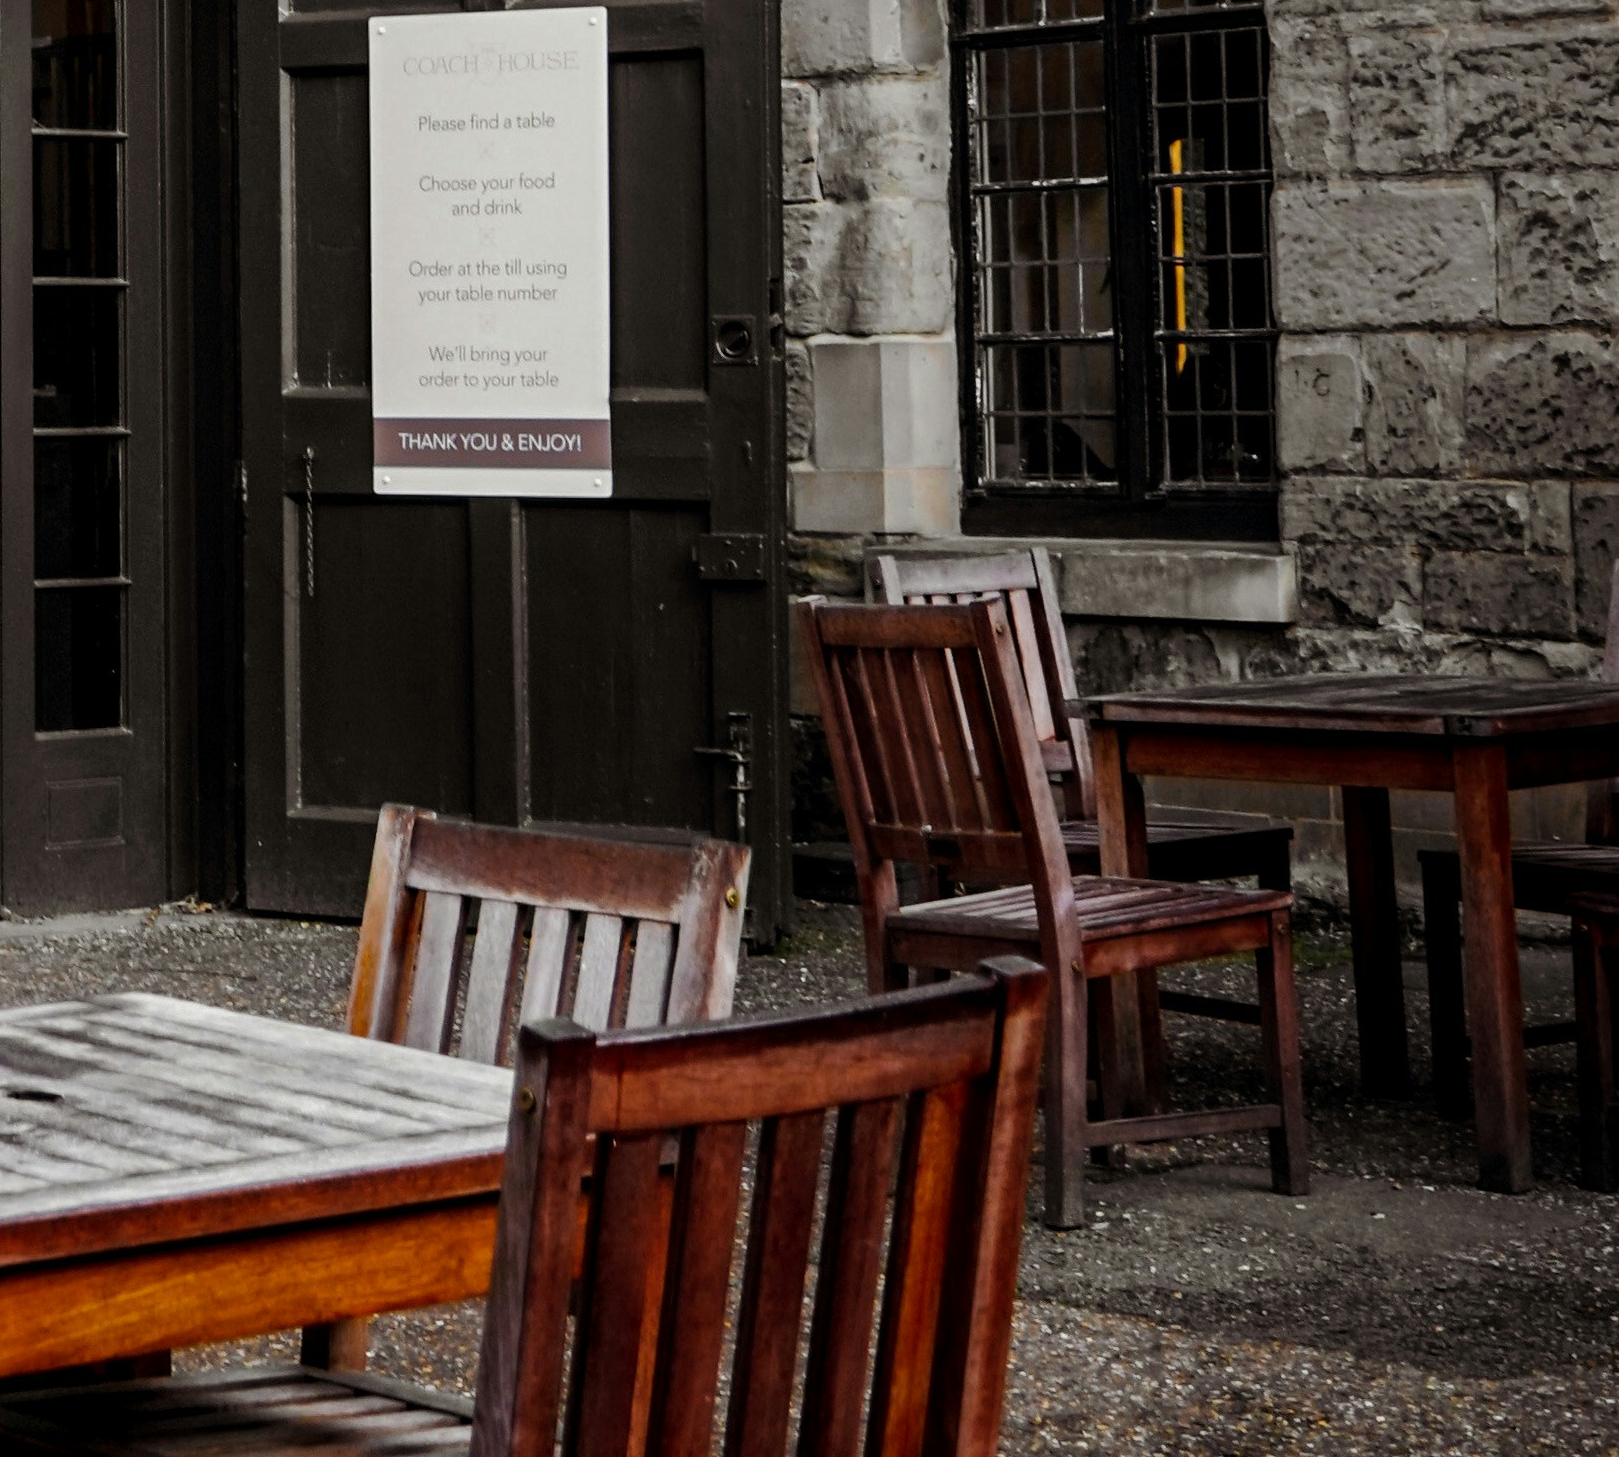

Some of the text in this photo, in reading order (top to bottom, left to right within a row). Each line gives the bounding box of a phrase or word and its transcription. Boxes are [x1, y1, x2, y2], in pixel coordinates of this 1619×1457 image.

[402, 51, 580, 76] COACH HOUSE
[418, 111, 556, 132] Please find a table
[418, 172, 555, 195] Choose your food
[452, 198, 523, 216] and drink
[408, 258, 568, 280] Order at the till using
[419, 283, 558, 306] your table number
[428, 345, 548, 366] We'll bring your
[419, 370, 559, 391] order to your table
[398, 432, 582, 452] THANK YOU & ENJOY!
